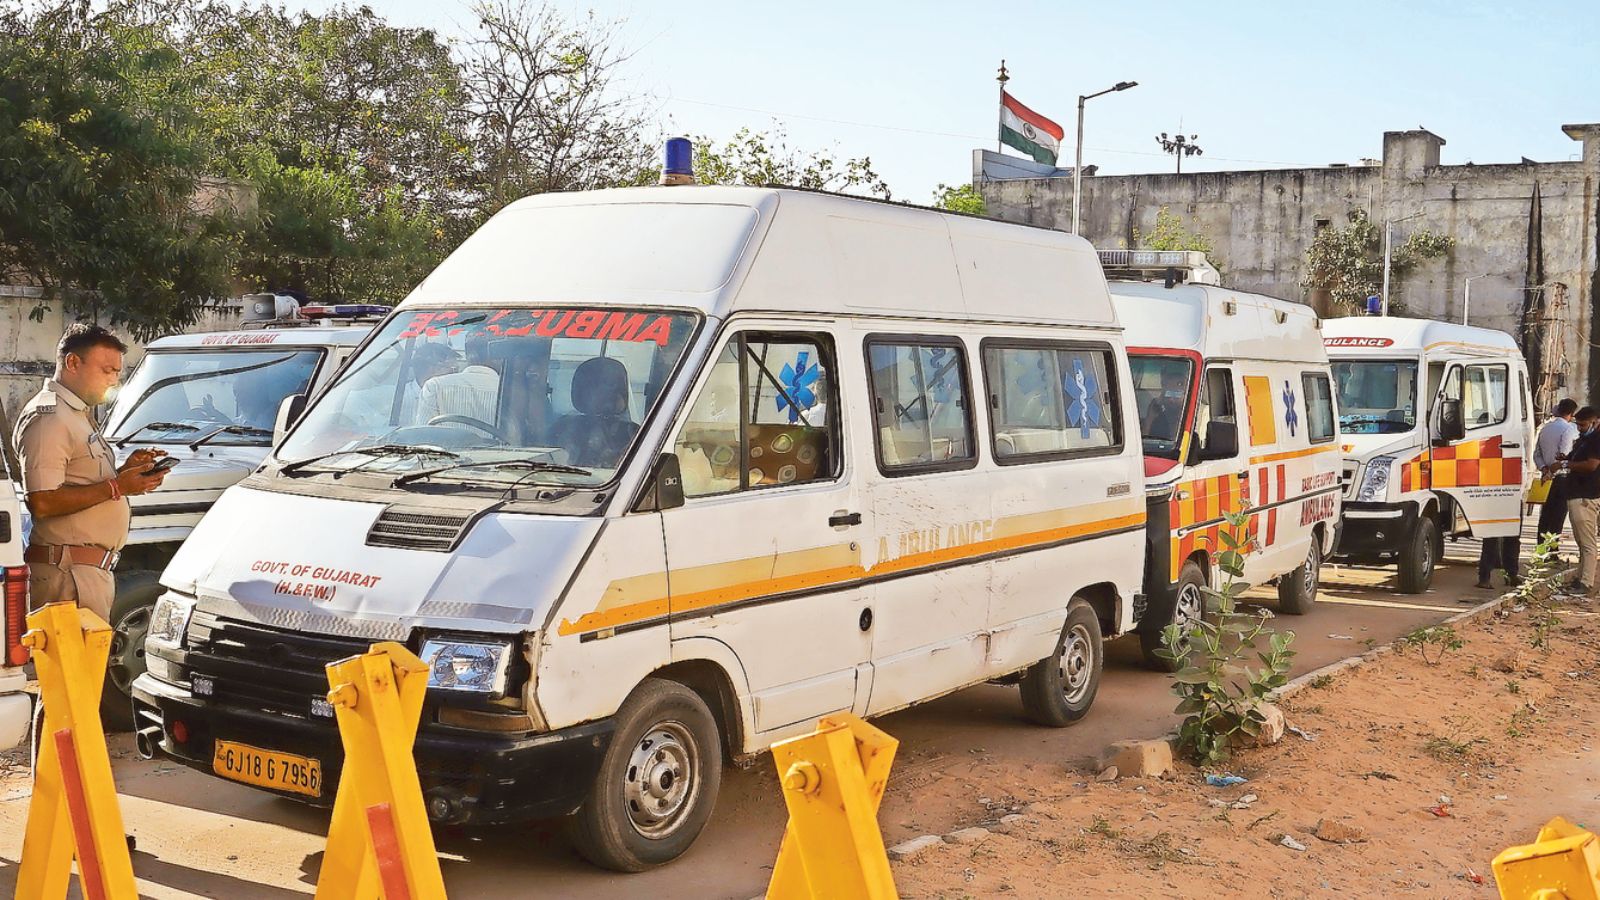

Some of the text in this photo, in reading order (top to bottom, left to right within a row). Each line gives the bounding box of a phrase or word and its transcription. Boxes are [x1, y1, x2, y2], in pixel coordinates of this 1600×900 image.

[226, 334, 238, 345] OF
[238, 333, 280, 344] GUJARAT
[1324, 338, 1386, 347] BULANCE
[251, 560, 382, 588] GOVT. OF GUJARAT
[226, 749, 318, 790] GJ18 G 7956
